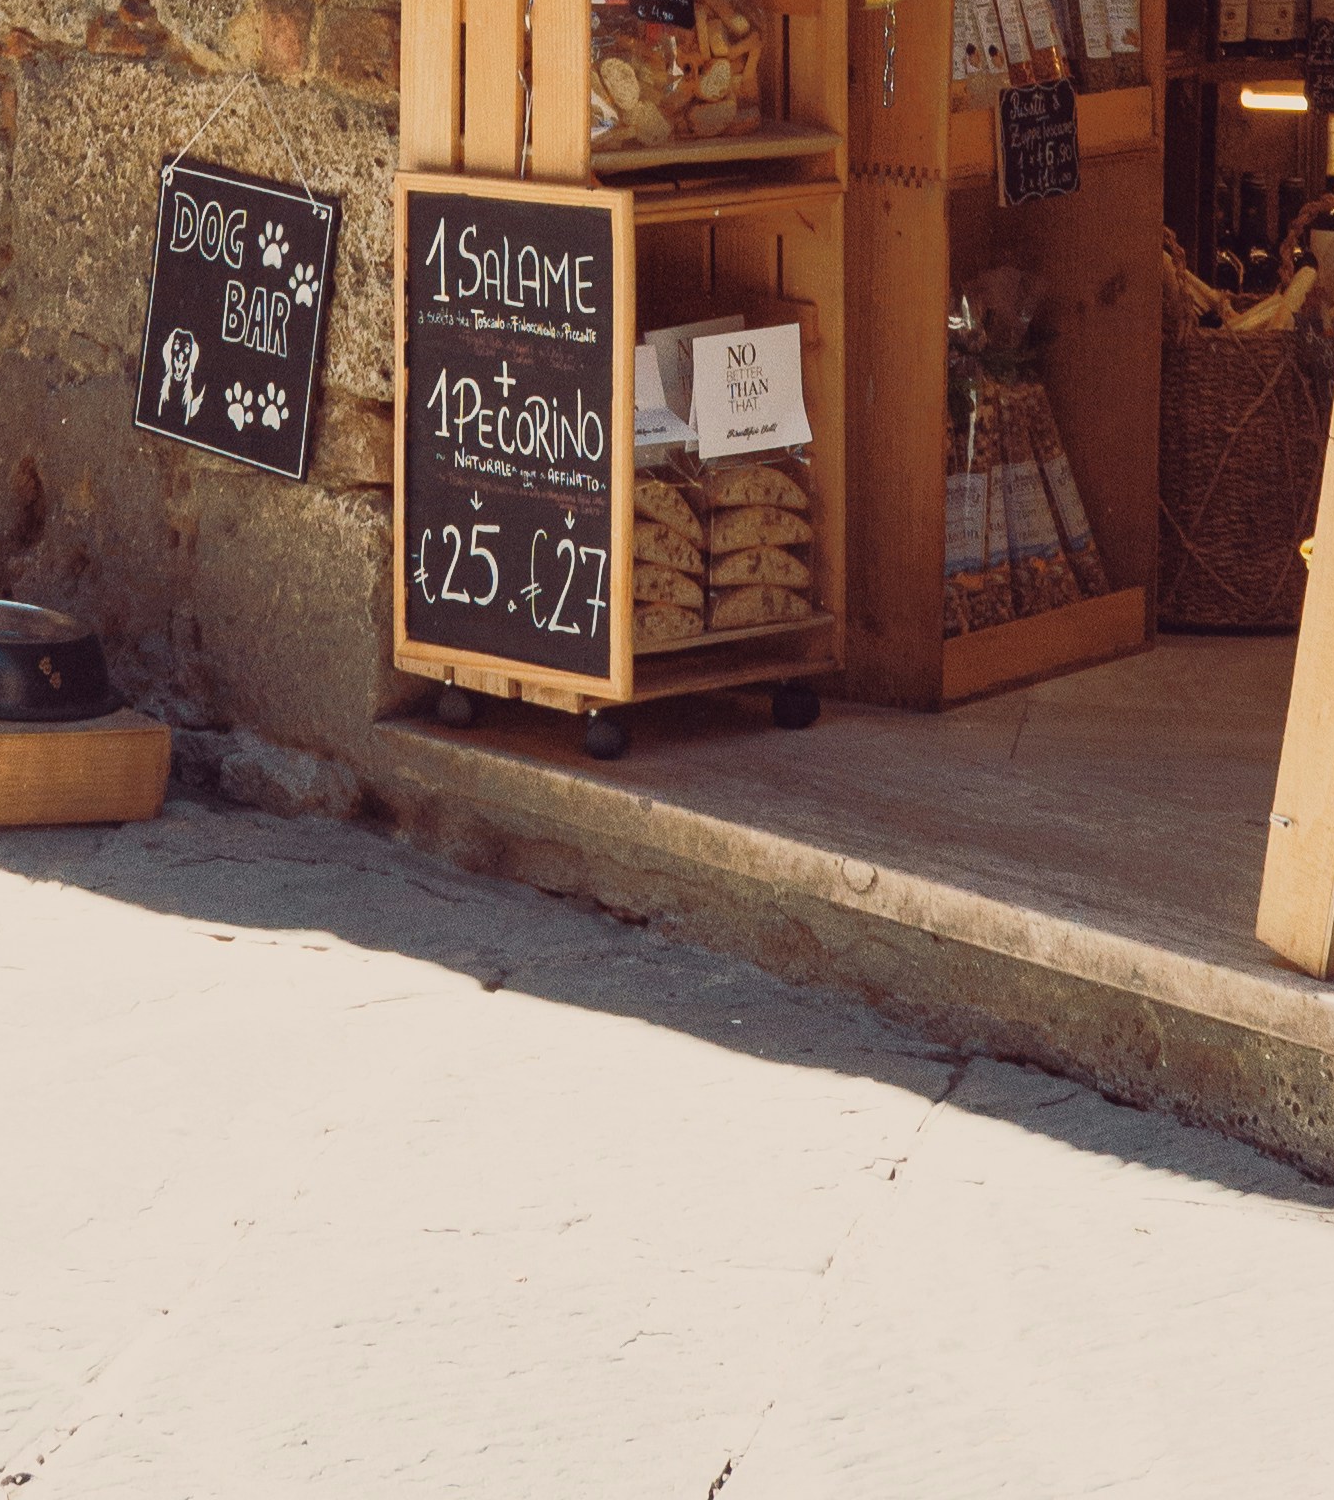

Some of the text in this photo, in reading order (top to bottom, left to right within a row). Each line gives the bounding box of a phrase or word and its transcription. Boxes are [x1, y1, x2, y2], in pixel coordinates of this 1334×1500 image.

[170, 192, 247, 269] DOG
[426, 217, 596, 314] 1 SALAME
[222, 280, 290, 357] BAR
[727, 342, 756, 368] NO
[727, 366, 763, 381] BETTER
[427, 368, 450, 438] 1
[727, 378, 769, 399] THAN
[454, 446, 512, 477] NATURALE
